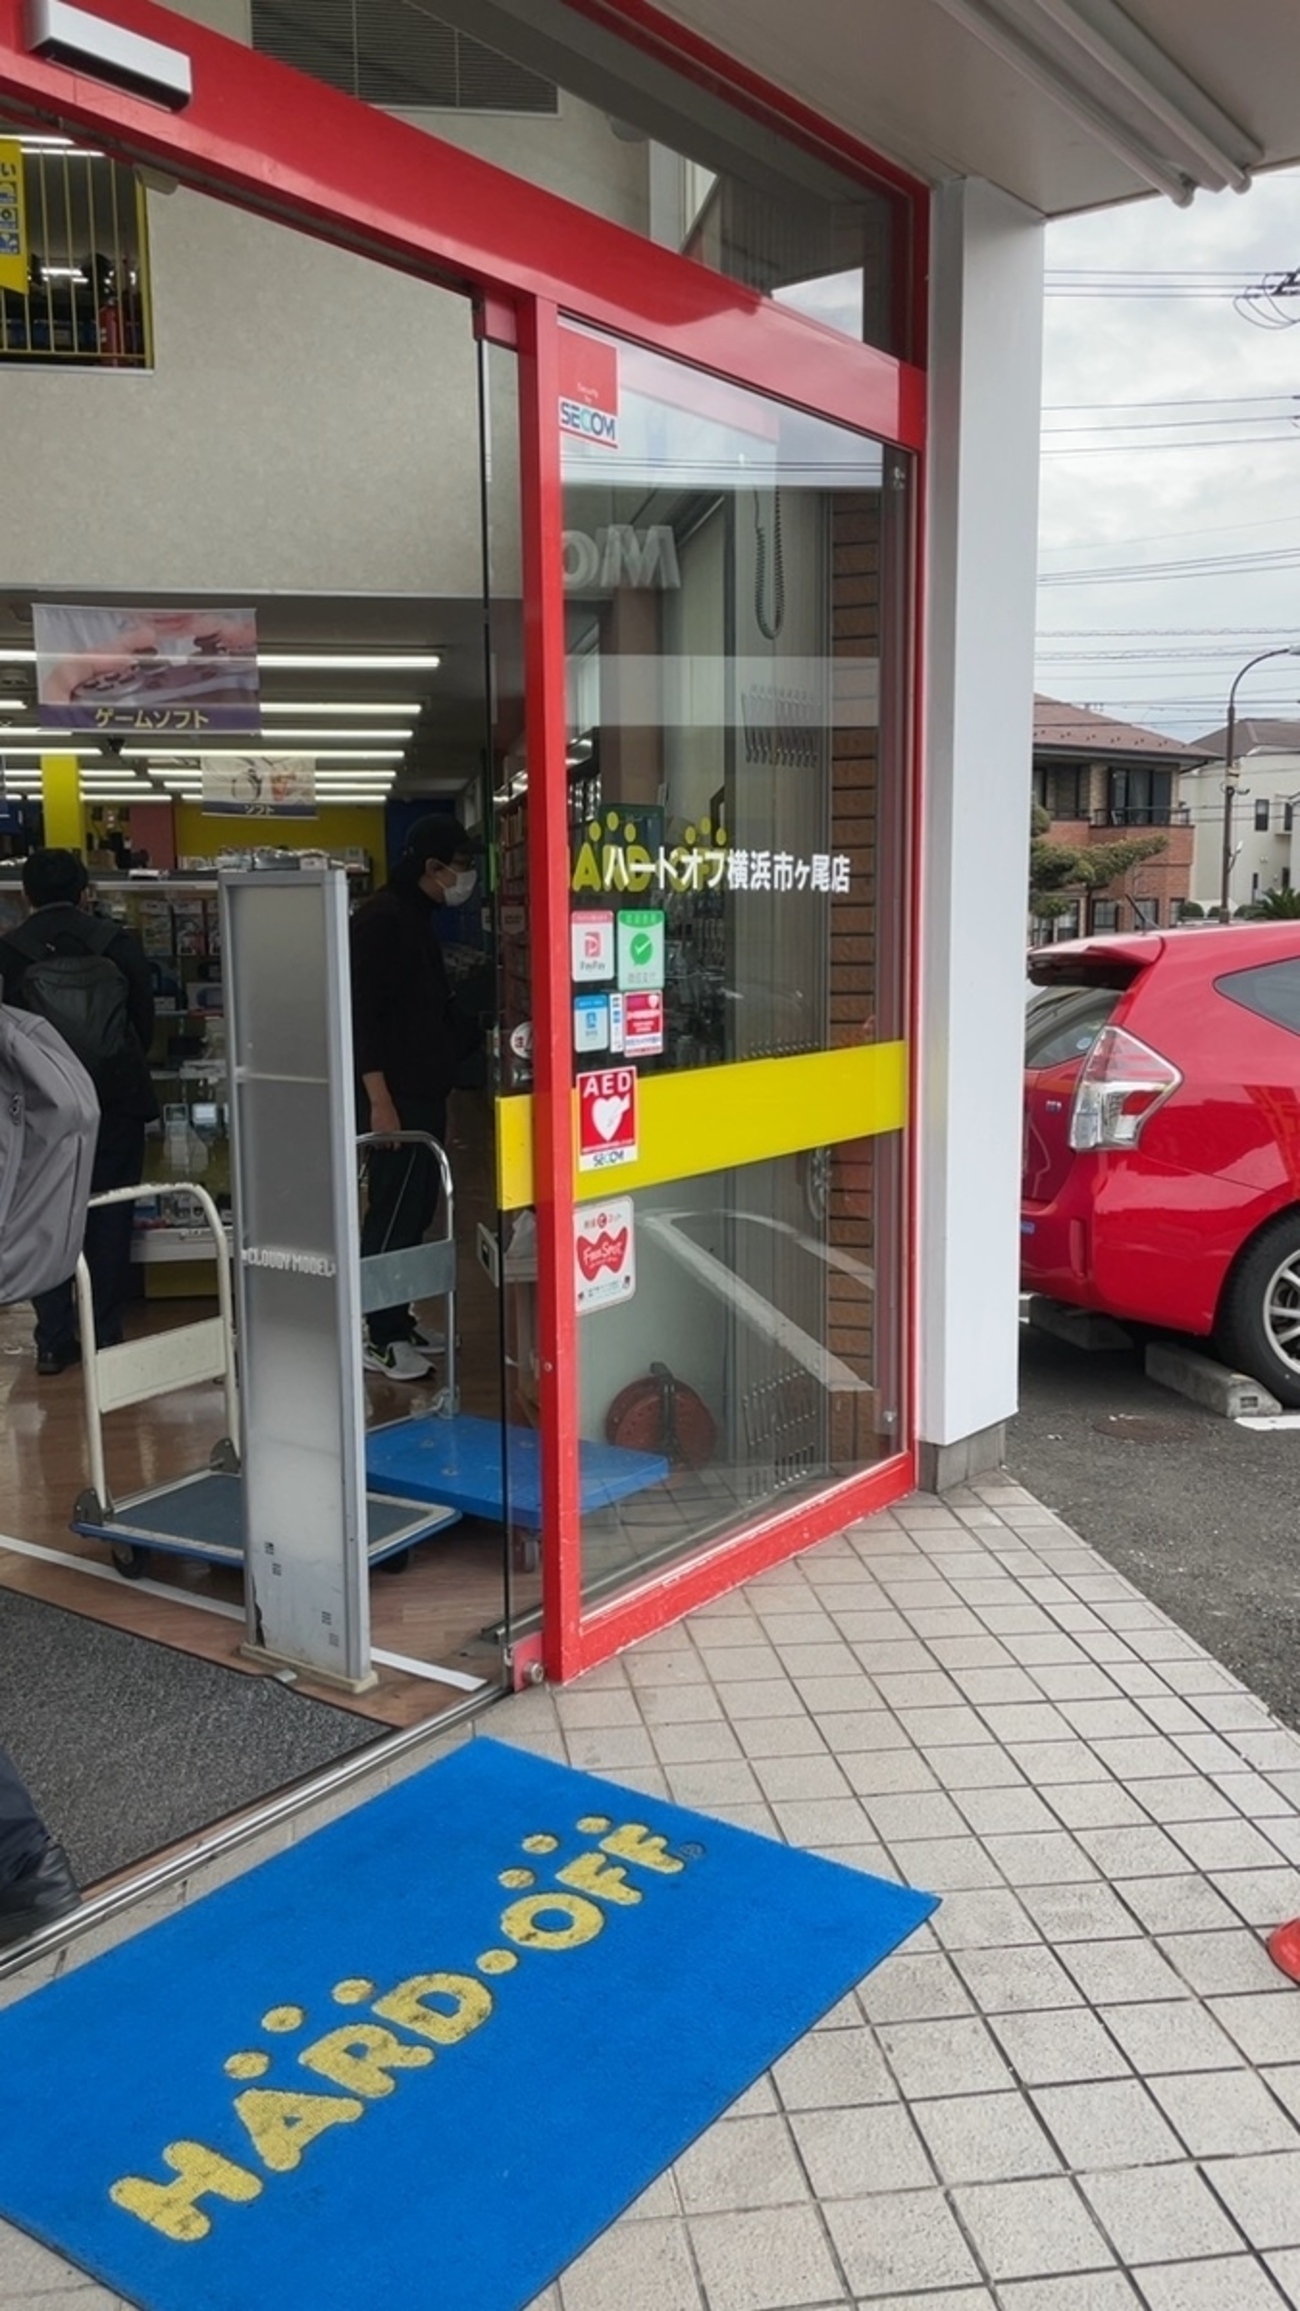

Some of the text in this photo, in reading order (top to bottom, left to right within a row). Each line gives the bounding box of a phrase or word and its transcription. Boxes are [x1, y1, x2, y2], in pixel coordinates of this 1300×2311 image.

[561, 401, 616, 441] SECOM
[95, 708, 209, 729] ゲームソフト
[583, 1071, 632, 1098] AED
